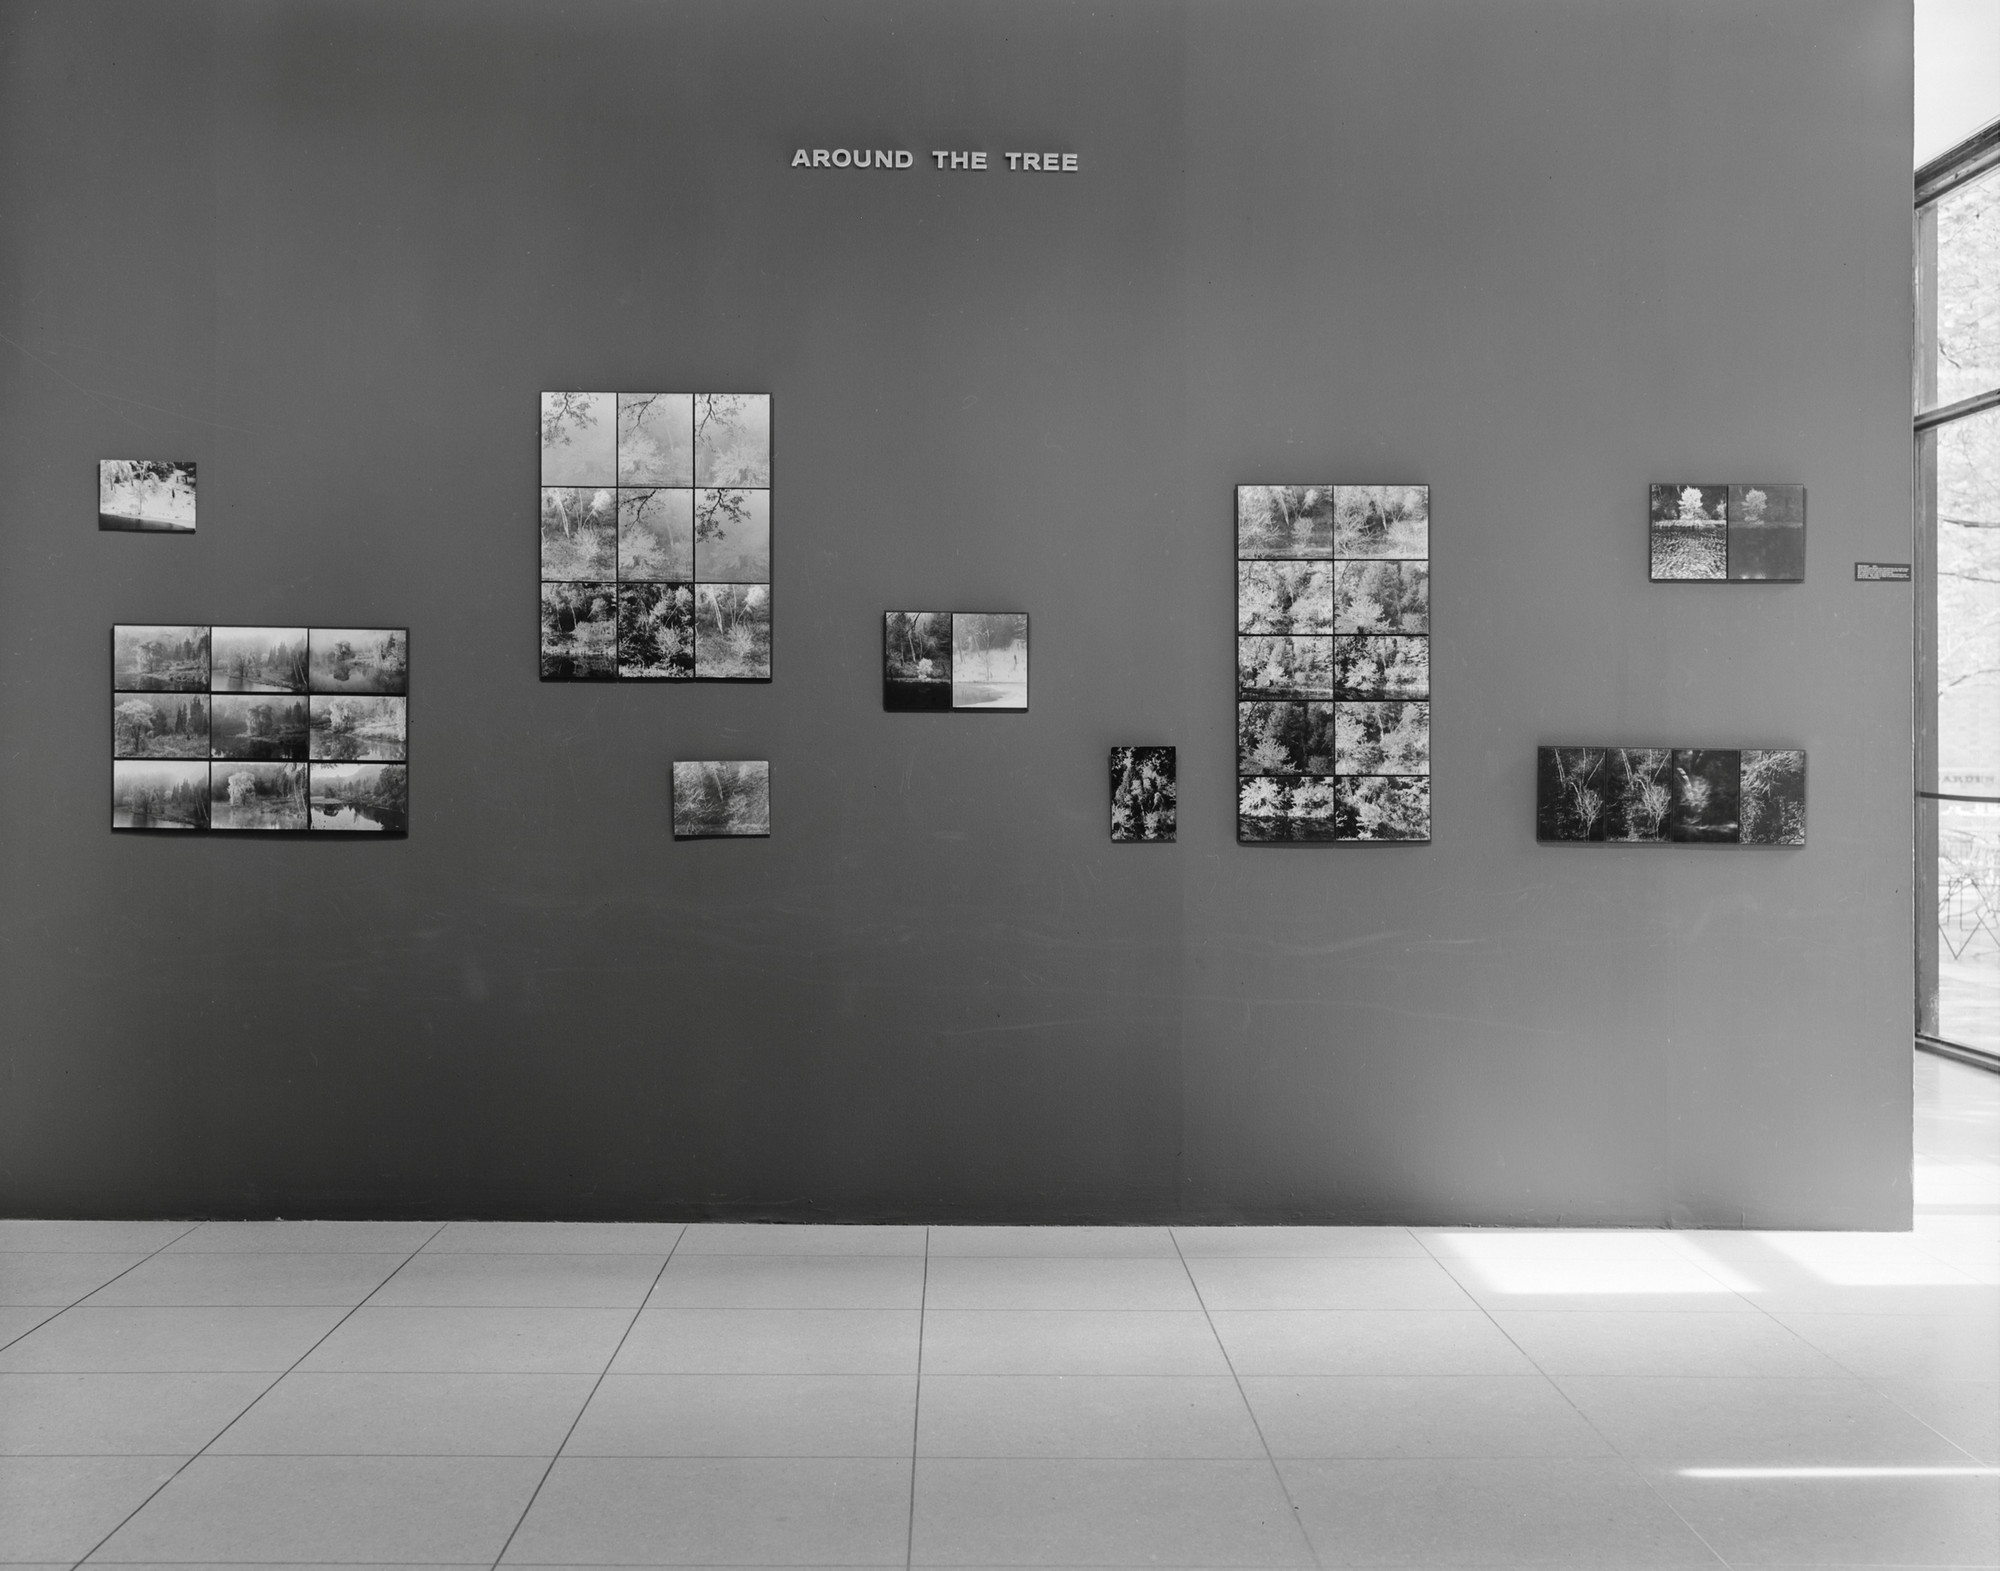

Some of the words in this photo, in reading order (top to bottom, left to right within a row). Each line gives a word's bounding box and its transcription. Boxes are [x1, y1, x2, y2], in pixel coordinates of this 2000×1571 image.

[791, 148, 914, 169] AROUND
[932, 150, 988, 170] THE
[1005, 152, 1079, 171] TREE
